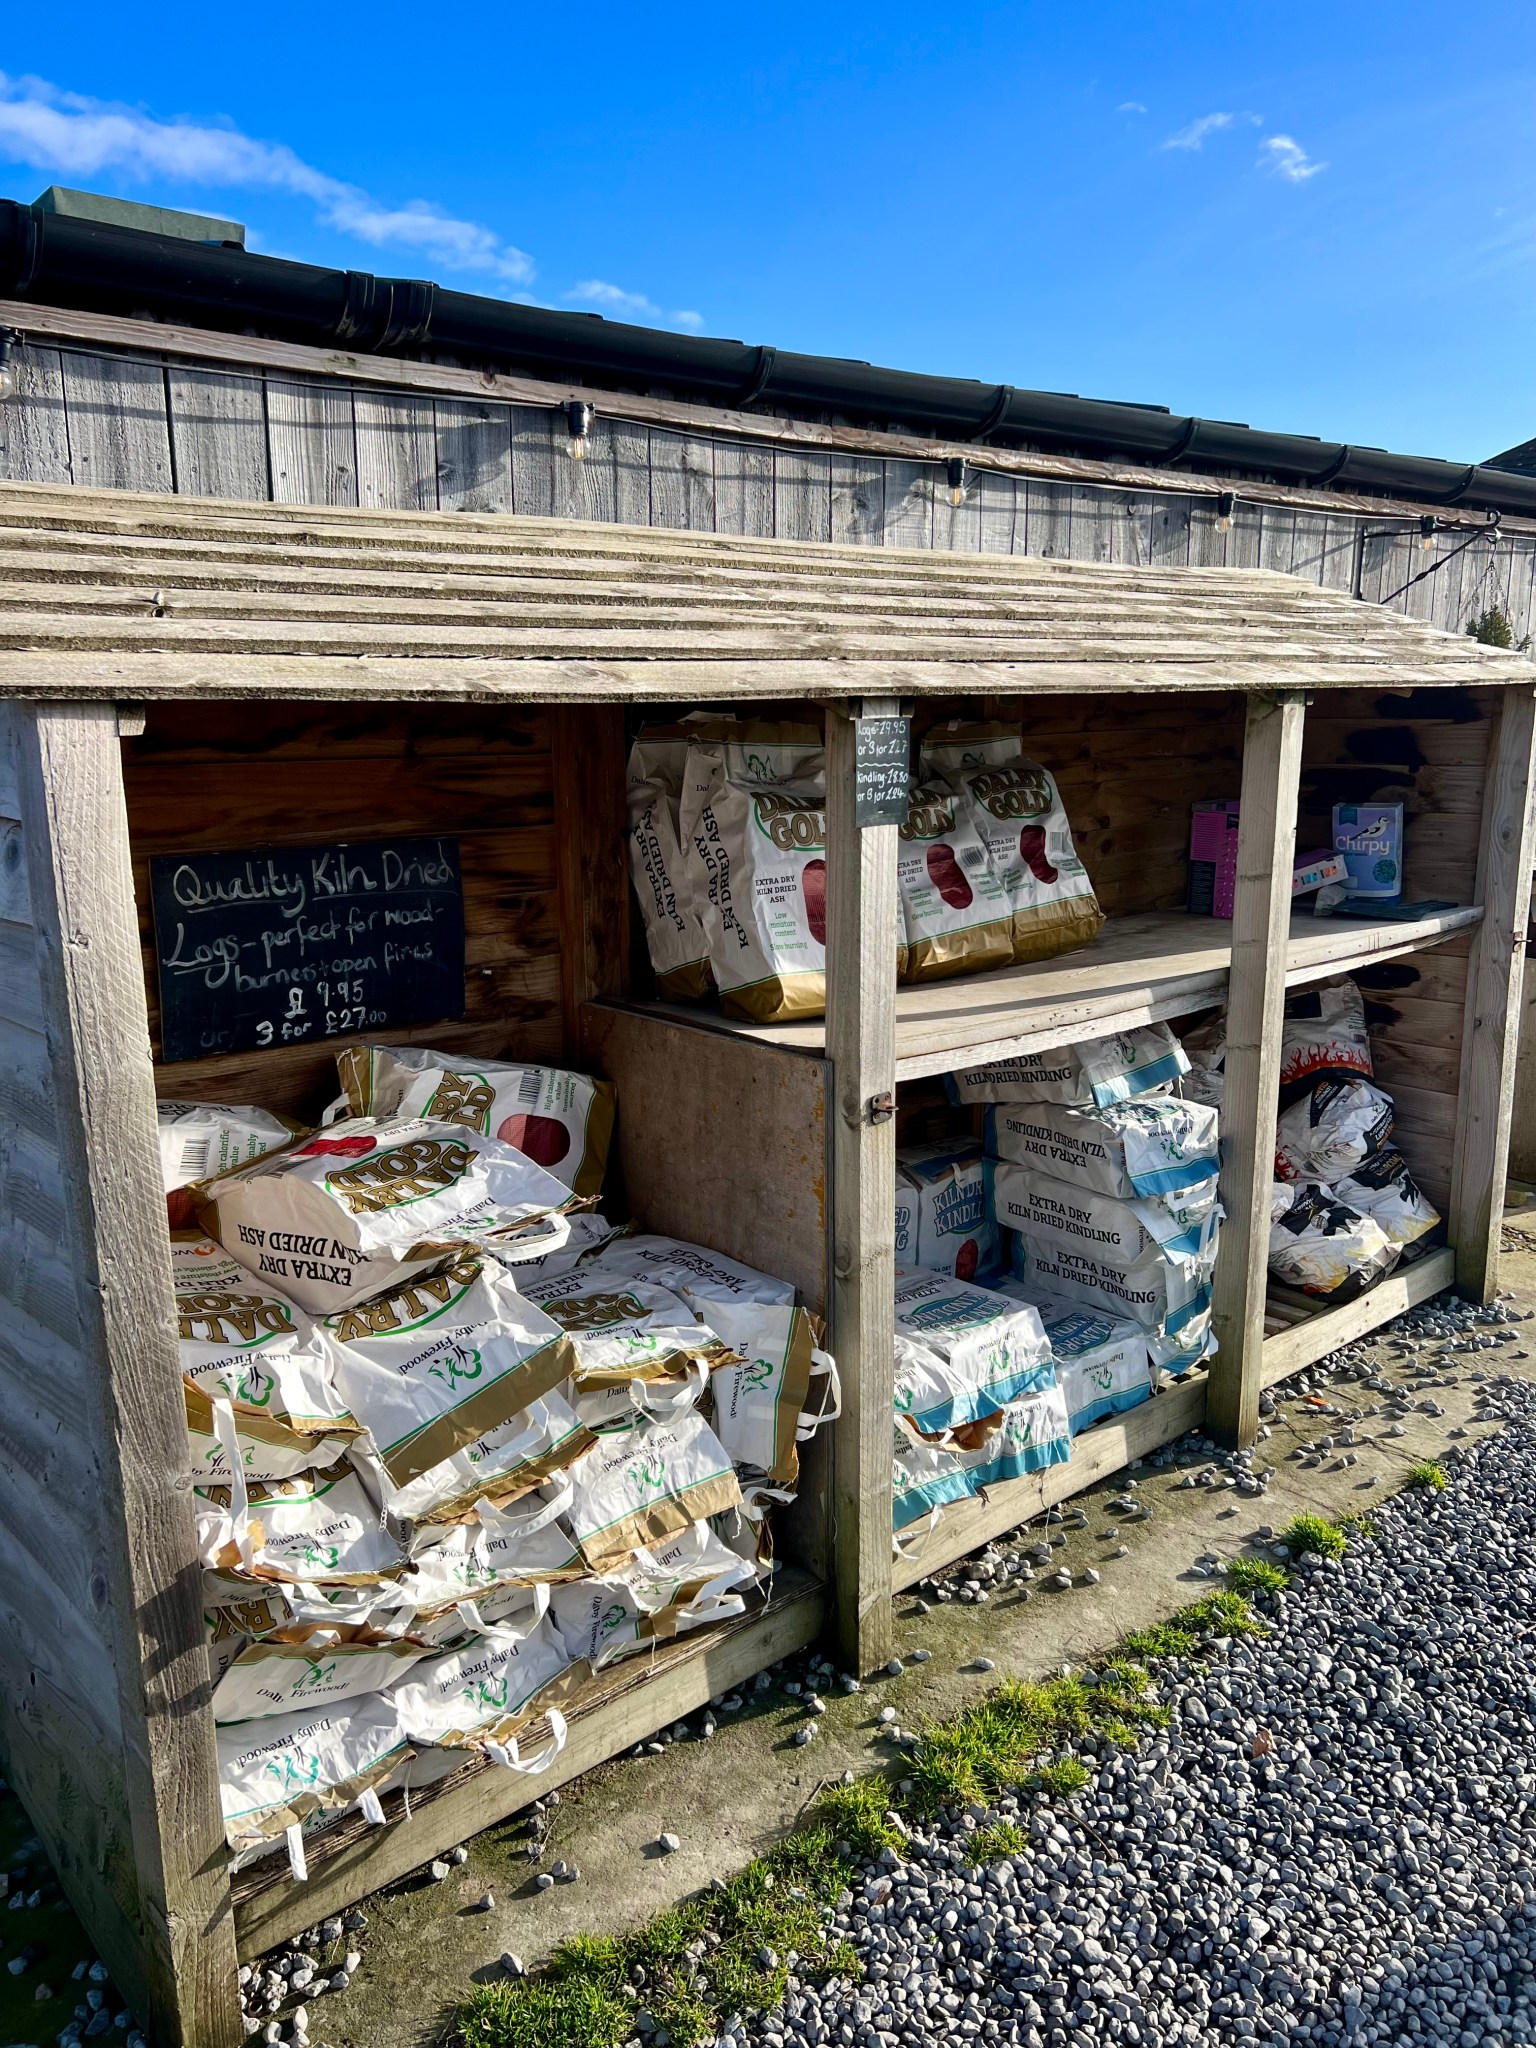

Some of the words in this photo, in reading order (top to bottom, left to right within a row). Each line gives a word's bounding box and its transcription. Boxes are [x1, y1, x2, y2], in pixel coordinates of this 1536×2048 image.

[988, 790, 1052, 820] GOLD
[702, 804, 721, 844] ASH
[769, 813, 827, 851] GOL
[632, 823, 650, 858] DRY
[694, 835, 717, 871] DRY
[1335, 835, 1391, 856] Chirpy
[649, 835, 672, 888] DRIED
[173, 857, 307, 918] Quality
[312, 852, 377, 897] Kiln
[381, 841, 454, 892] Dried
[715, 847, 732, 905] DRIED
[755, 877, 779, 887] EXTRA
[780, 875, 795, 883] DRY
[644, 864, 667, 919] EXTRA
[756, 887, 774, 896] KILN
[774, 884, 797, 893] DRIED
[770, 895, 786, 904] ASH
[256, 1020, 274, 1045] 3
[281, 1022, 313, 1041] for
[1019, 1055, 1043, 1068] DRY
[546, 1069, 558, 1096] calorifi
[1006, 1118, 1053, 1142] KINDLING
[1054, 1131, 1080, 1151] DRIED
[1025, 1140, 1047, 1157] DRY
[1050, 1146, 1088, 1168] EXTRA
[324, 1140, 442, 1192] GOLD
[342, 1143, 481, 1214] DALBY
[465, 1196, 497, 1216] Dalby
[1029, 1192, 1066, 1216] EXTRA
[1068, 1205, 1093, 1225] DRY
[238, 1223, 266, 1248] ASH
[1008, 1201, 1031, 1220] KILN
[1033, 1210, 1064, 1230] DRIED
[1065, 1220, 1122, 1245] KINDLING
[269, 1232, 328, 1258] DRIED
[259, 1252, 288, 1277] DRY
[291, 1259, 352, 1287] EXTRA
[1056, 1251, 1099, 1275] EXTRA
[1101, 1265, 1127, 1285] DRY
[555, 1272, 590, 1285] KILN
[711, 1269, 747, 1287] DRY
[1035, 1258, 1060, 1277] KILN
[1062, 1268, 1098, 1286] DRIED
[1099, 1278, 1156, 1304] KINDLING
[534, 1282, 584, 1301] EXTRA
[188, 1352, 254, 1379] Firewood
[398, 1335, 456, 1376] Firewood
[730, 1371, 743, 1418] Firewood
[265, 1530, 314, 1547] Firewoo
[315, 1519, 352, 1537] Dalby
[490, 1645, 520, 1665] Dalby
[290, 1682, 348, 1698] Firewood
[440, 1660, 489, 1694] Firewood
[297, 1718, 332, 1739] Dalby
[239, 1733, 296, 1768] Firewood
